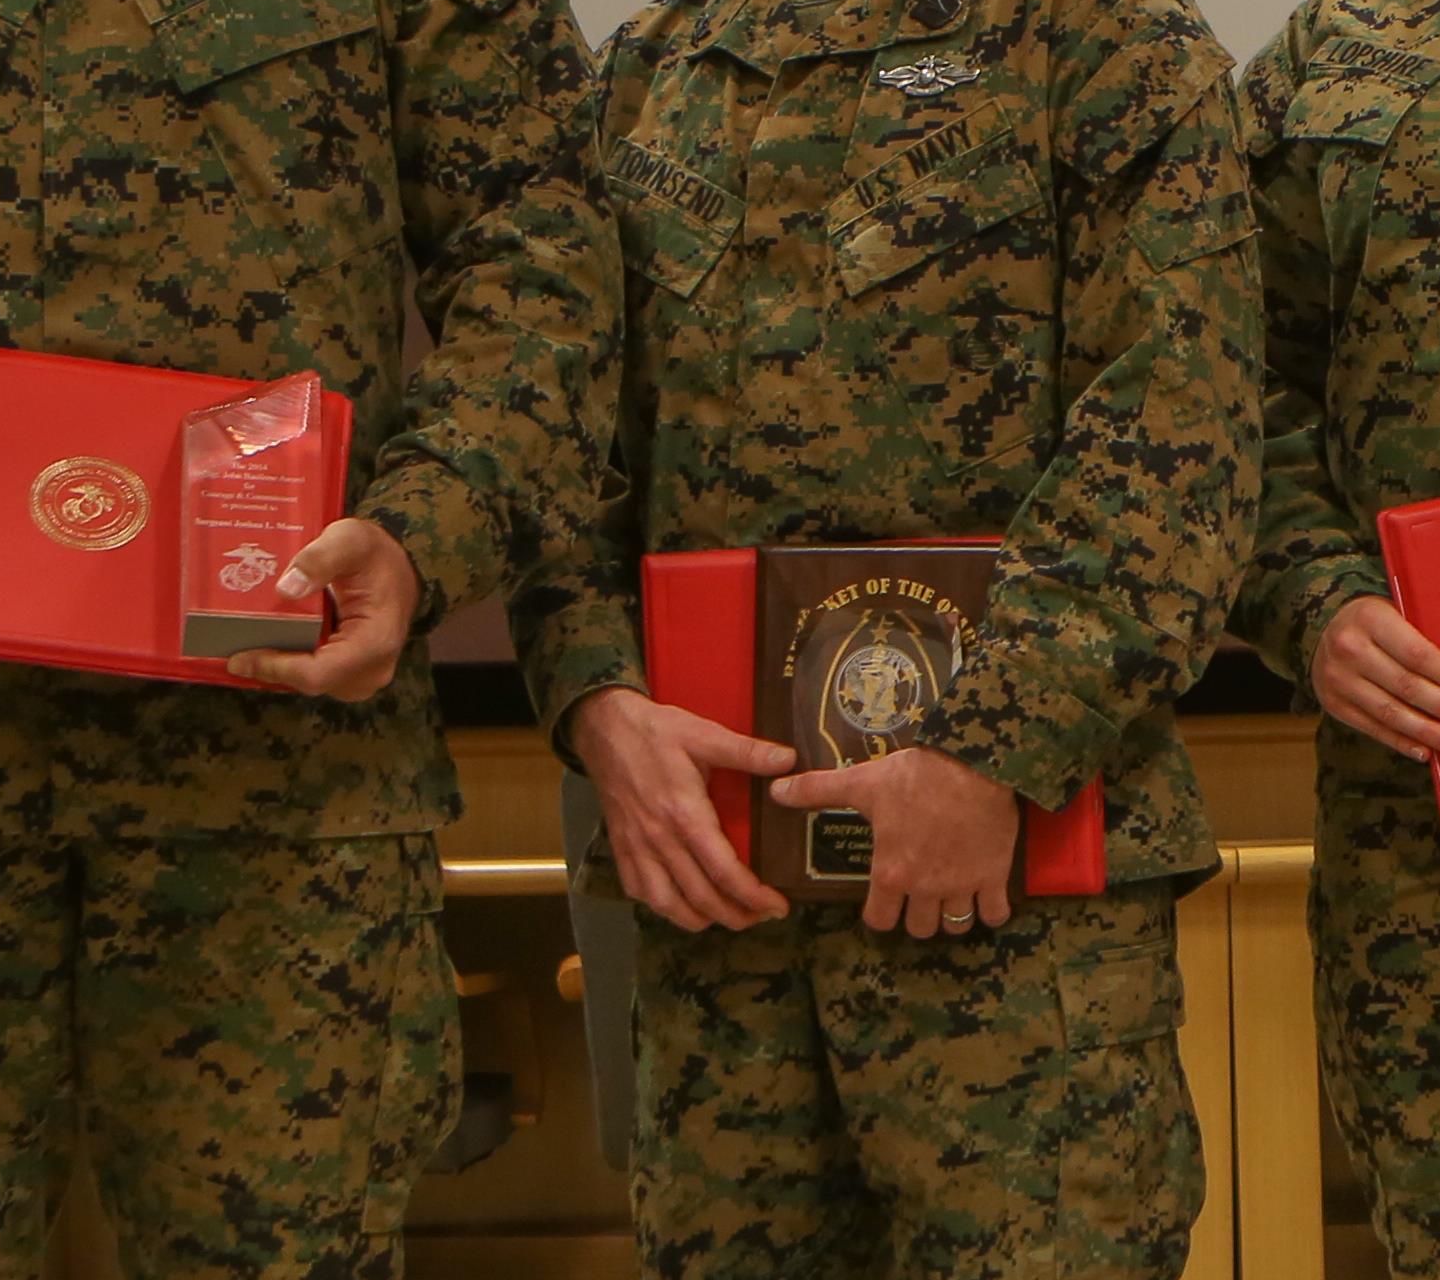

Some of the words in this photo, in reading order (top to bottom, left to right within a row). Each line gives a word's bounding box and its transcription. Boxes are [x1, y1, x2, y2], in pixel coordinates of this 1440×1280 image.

[1326, 38, 1435, 78] LOPSHIRE
[615, 139, 726, 222] TOWNSEND
[854, 166, 903, 210] U.S.
[905, 119, 973, 180] NAVY
[865, 577, 891, 596] OF
[897, 578, 936, 605] THE
